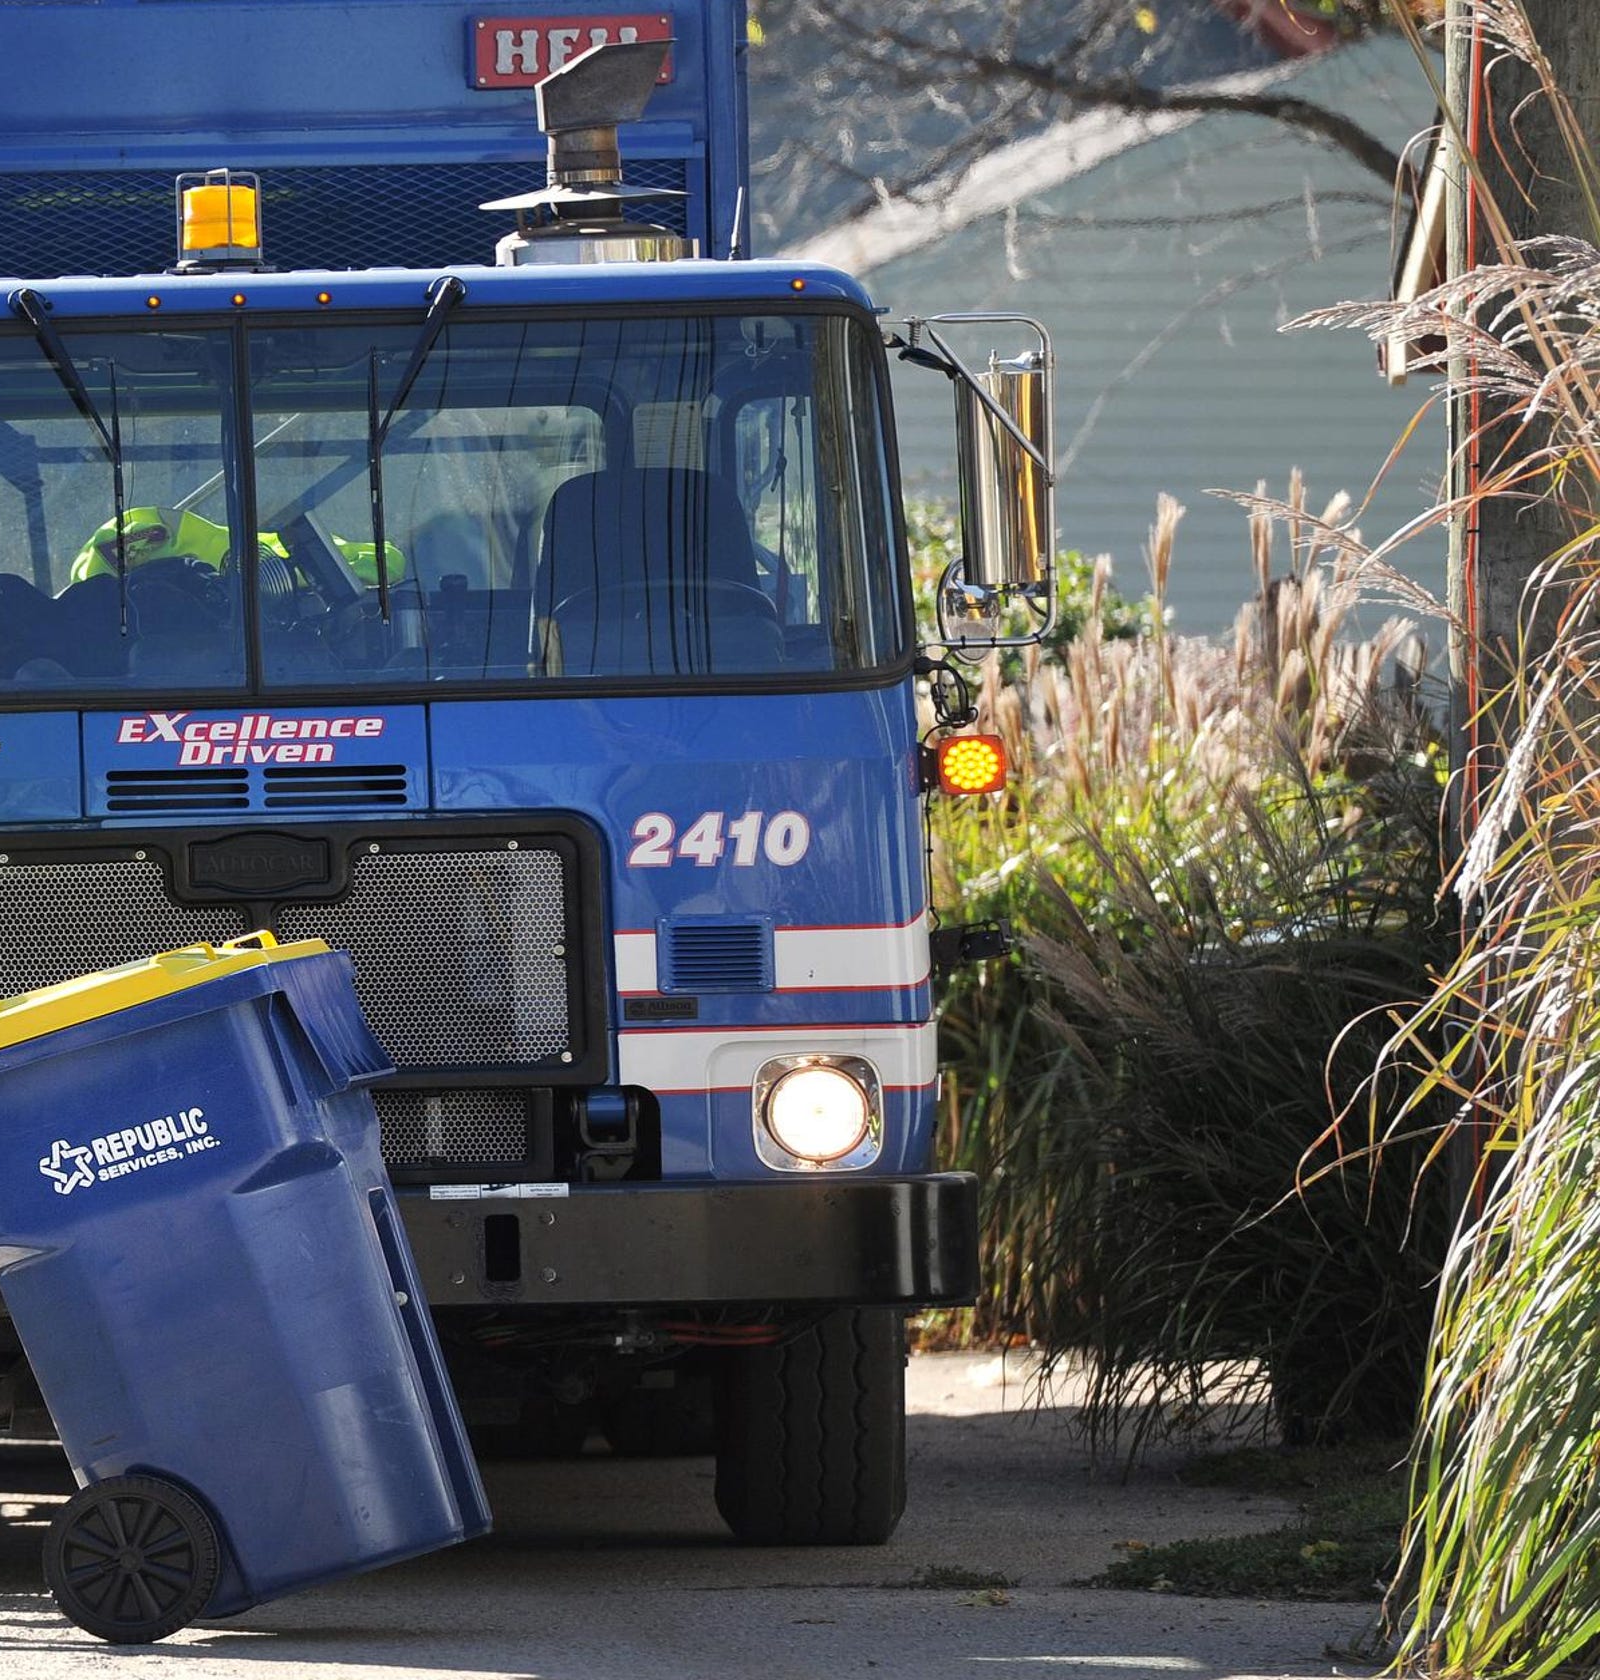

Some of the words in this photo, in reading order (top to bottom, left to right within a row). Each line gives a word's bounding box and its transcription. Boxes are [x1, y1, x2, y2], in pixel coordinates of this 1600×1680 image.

[495, 26, 638, 74] HE
[117, 711, 385, 744] EXcellence
[178, 739, 335, 766] Driven
[626, 810, 811, 868] 2410
[206, 854, 314, 874] AUTOCAR
[91, 1107, 208, 1166] REPUBLIC
[97, 1147, 184, 1182] SERVICES,
[185, 1135, 221, 1155] INC.
